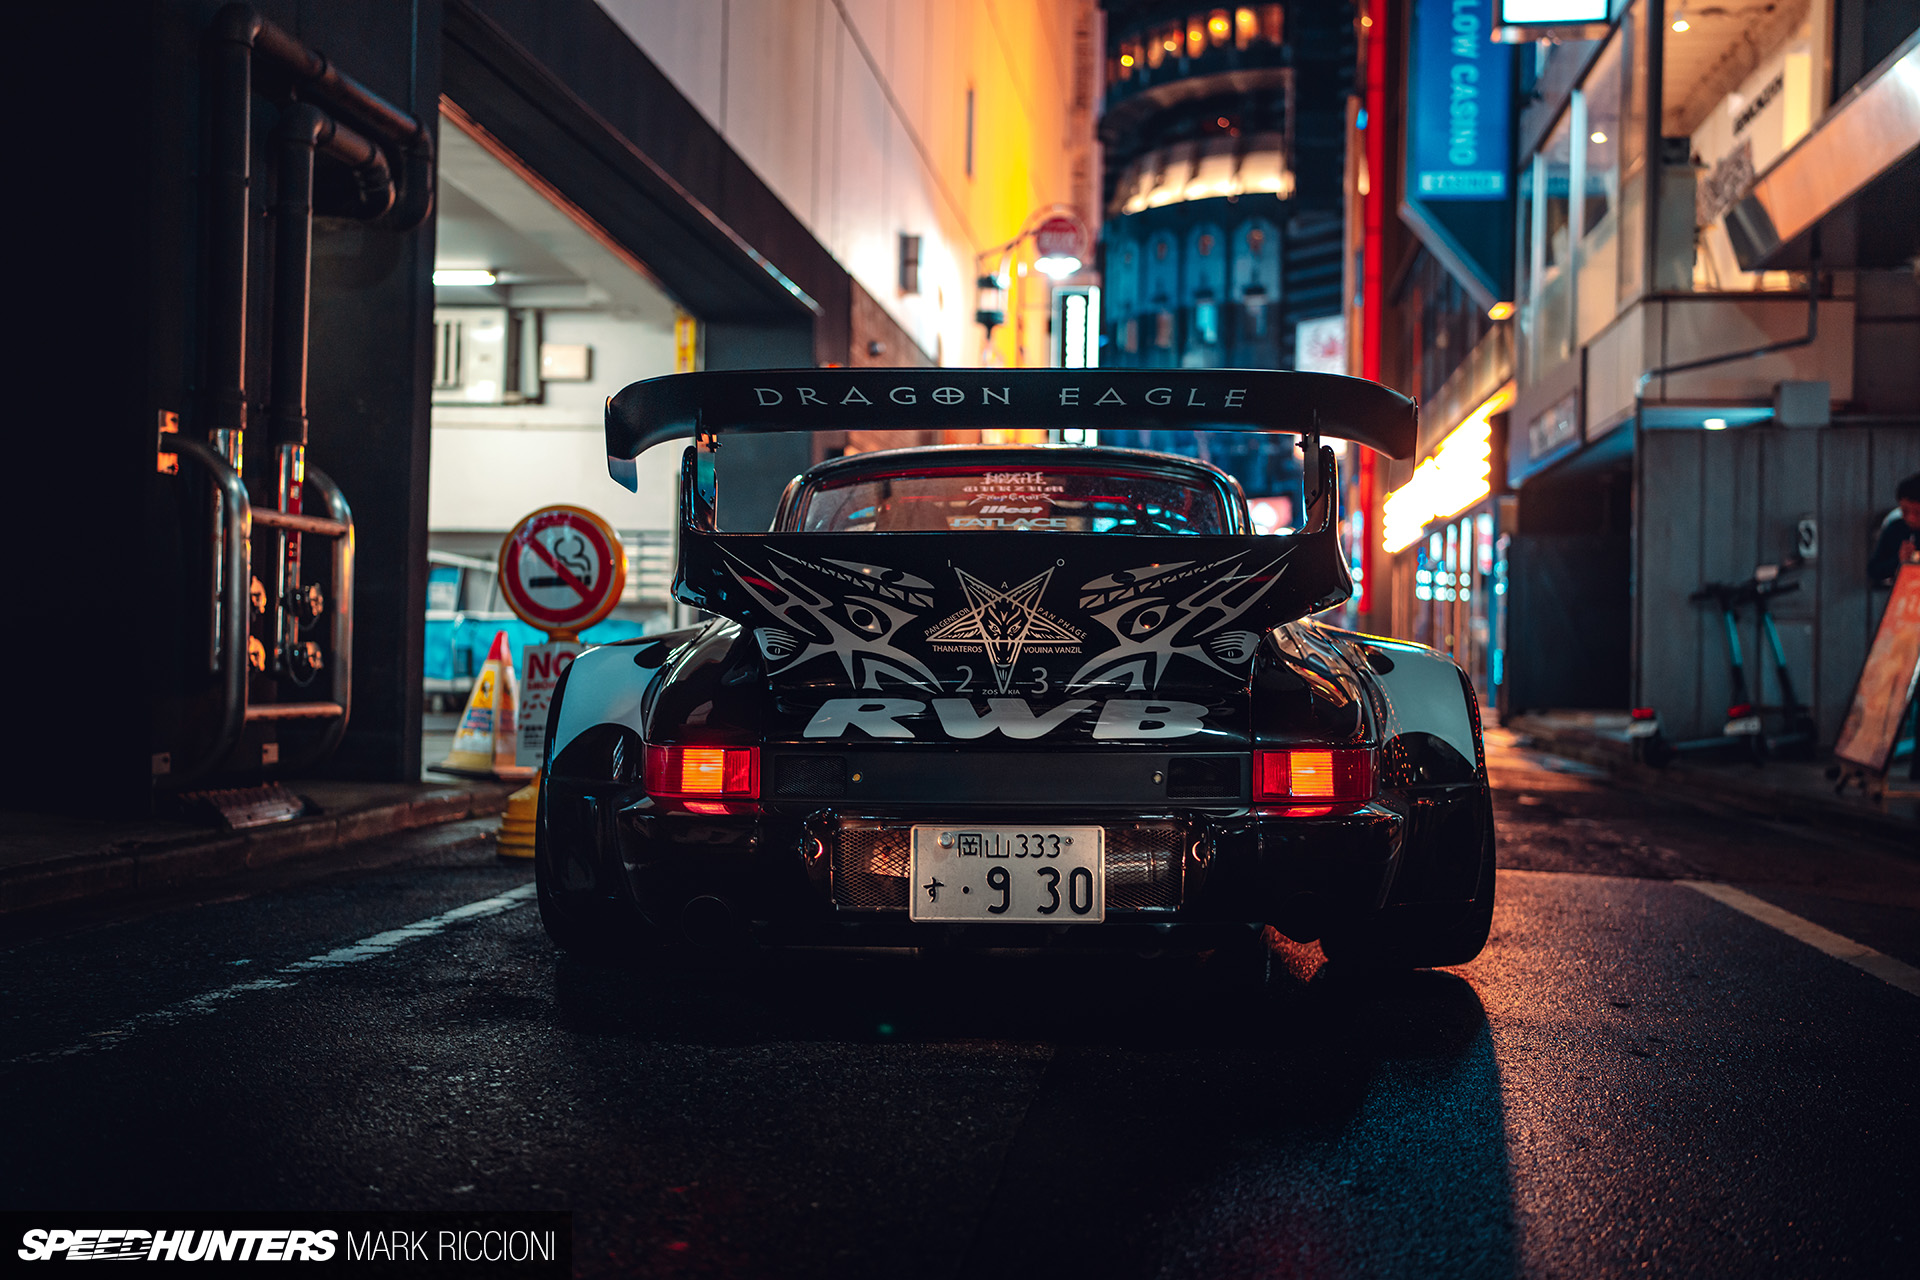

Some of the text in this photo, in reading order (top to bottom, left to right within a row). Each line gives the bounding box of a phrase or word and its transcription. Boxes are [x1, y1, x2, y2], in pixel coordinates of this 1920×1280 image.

[1449, 64, 1479, 166] CASINO
[754, 386, 1247, 408] DRAGON EAGLE
[939, 607, 971, 628] GENETOR
[1037, 607, 1088, 640] PAN PHAGE
[932, 645, 983, 653] THANATEROS
[1054, 646, 1082, 654] VANZIL
[955, 665, 1049, 694] 2 3
[803, 699, 1209, 739] RWB
[922, 877, 945, 903] す
